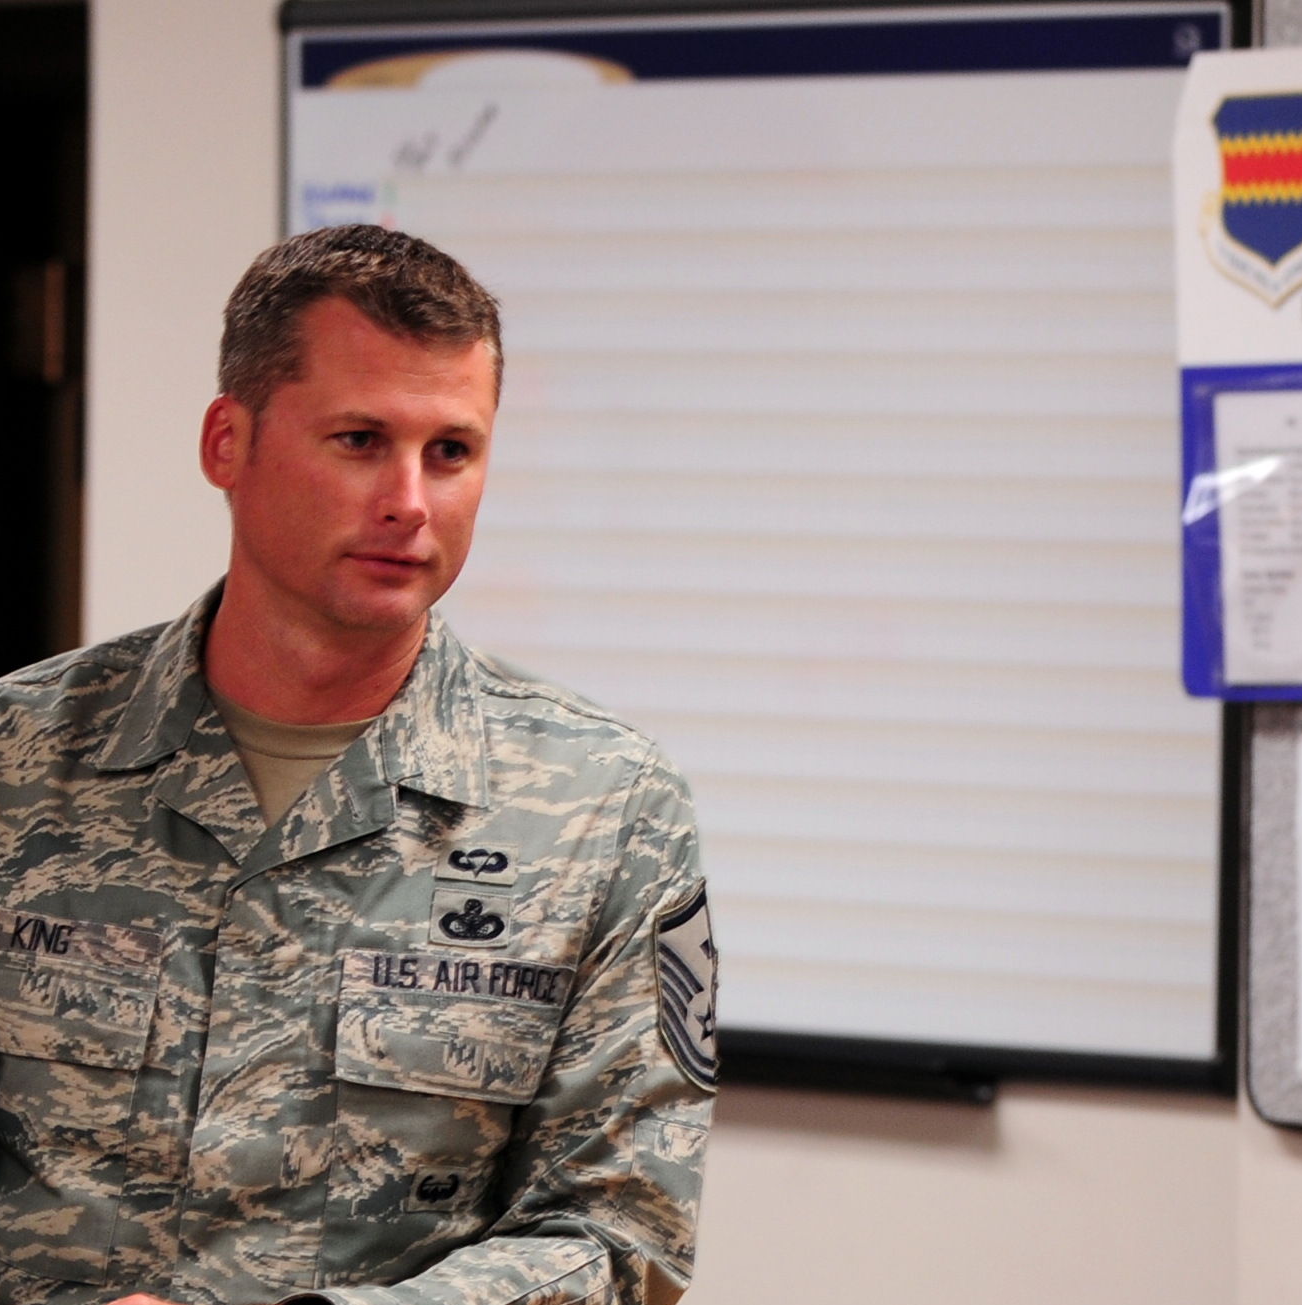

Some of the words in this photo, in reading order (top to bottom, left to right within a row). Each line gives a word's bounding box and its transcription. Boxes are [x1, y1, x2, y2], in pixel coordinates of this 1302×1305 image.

[10, 915, 75, 955] KING
[373, 955, 424, 990] U.S.
[433, 959, 481, 994] AIR
[488, 962, 561, 1004] FORCE
